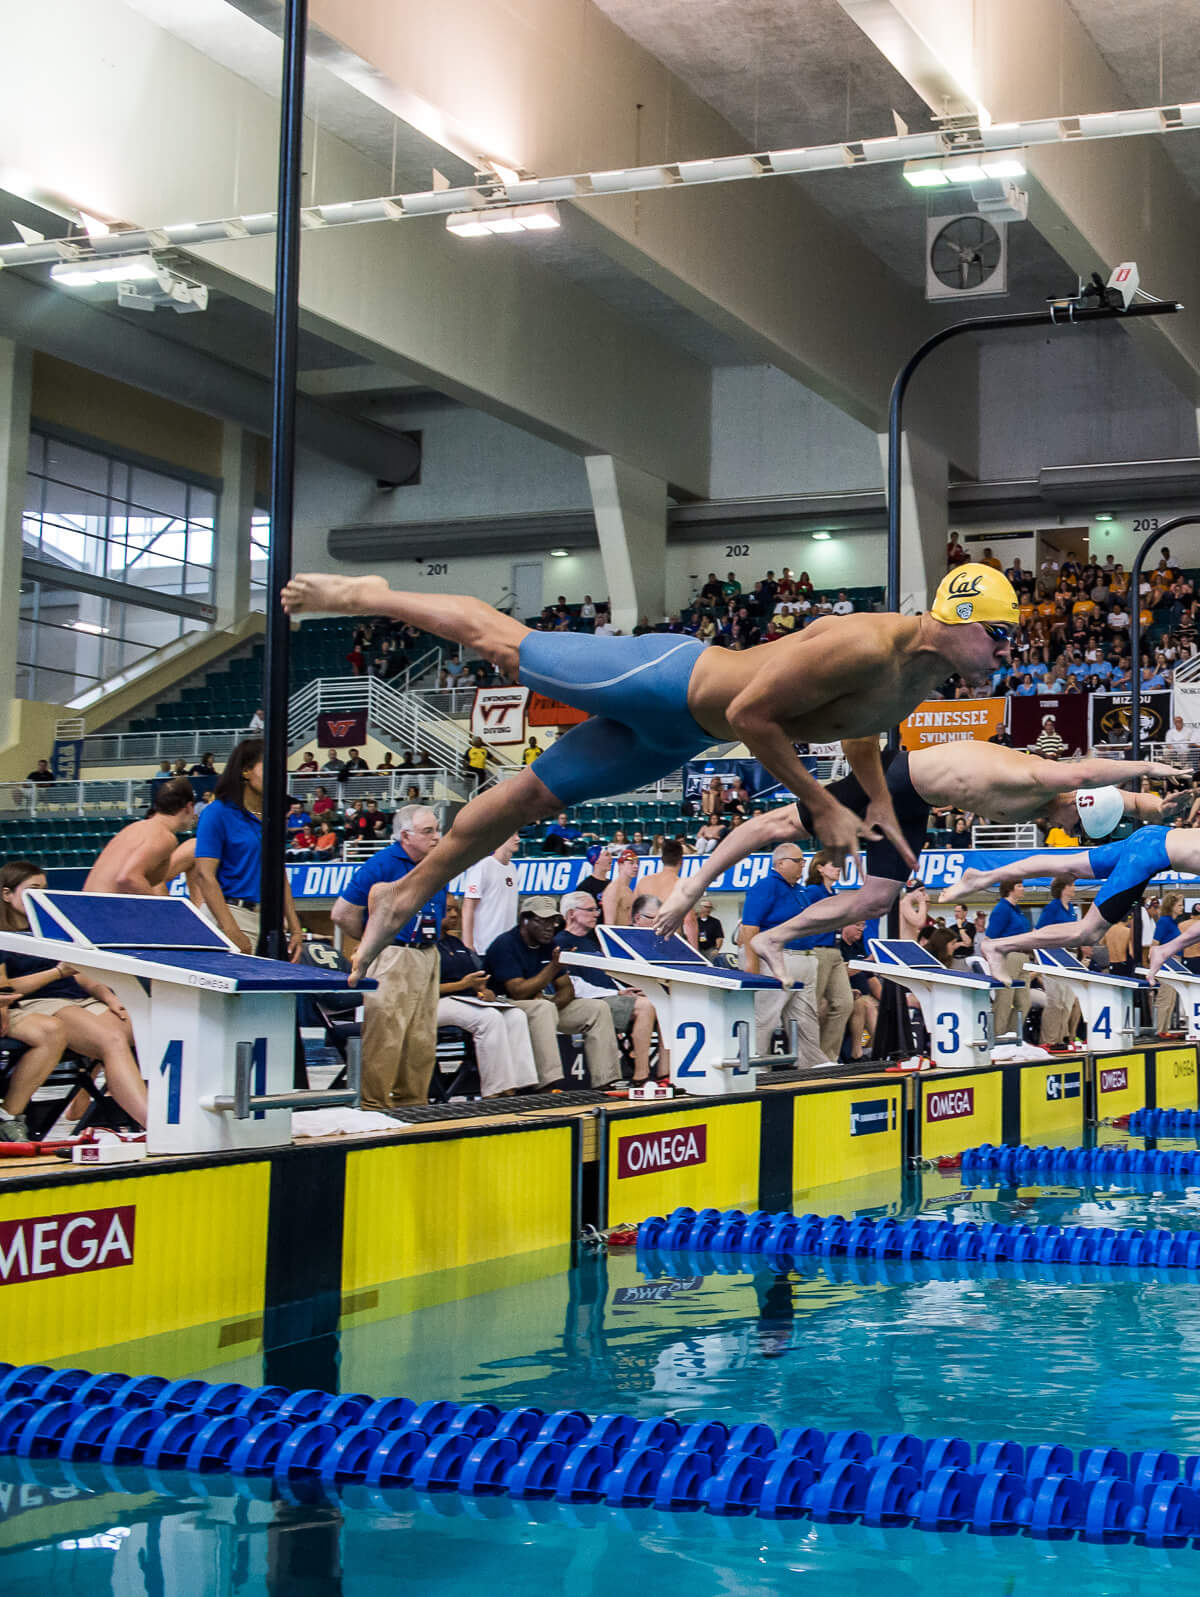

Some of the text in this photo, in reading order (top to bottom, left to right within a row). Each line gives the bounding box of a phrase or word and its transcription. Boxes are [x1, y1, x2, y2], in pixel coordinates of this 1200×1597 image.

[1133, 518, 1159, 532] 203
[725, 544, 750, 557] 202
[427, 563, 448, 576] 201
[947, 572, 983, 600] Cal
[1112, 696, 1151, 705] MIZOU
[480, 703, 521, 724] VT
[907, 710, 988, 727] TENNESSEE
[327, 719, 356, 738] VT
[920, 731, 975, 743] SWIMMING
[199, 977, 229, 990] OMEGA
[936, 1012, 960, 1053] 3
[1092, 1006, 1112, 1039] 4
[676, 1021, 706, 1078] 2
[571, 1054, 585, 1080] 4
[160, 1040, 183, 1124] 1
[1102, 1070, 1128, 1090] OMEGA
[930, 1091, 971, 1118] OMEGA
[627, 1132, 700, 1171] OMEGA
[0, 1213, 132, 1279] MEGA
